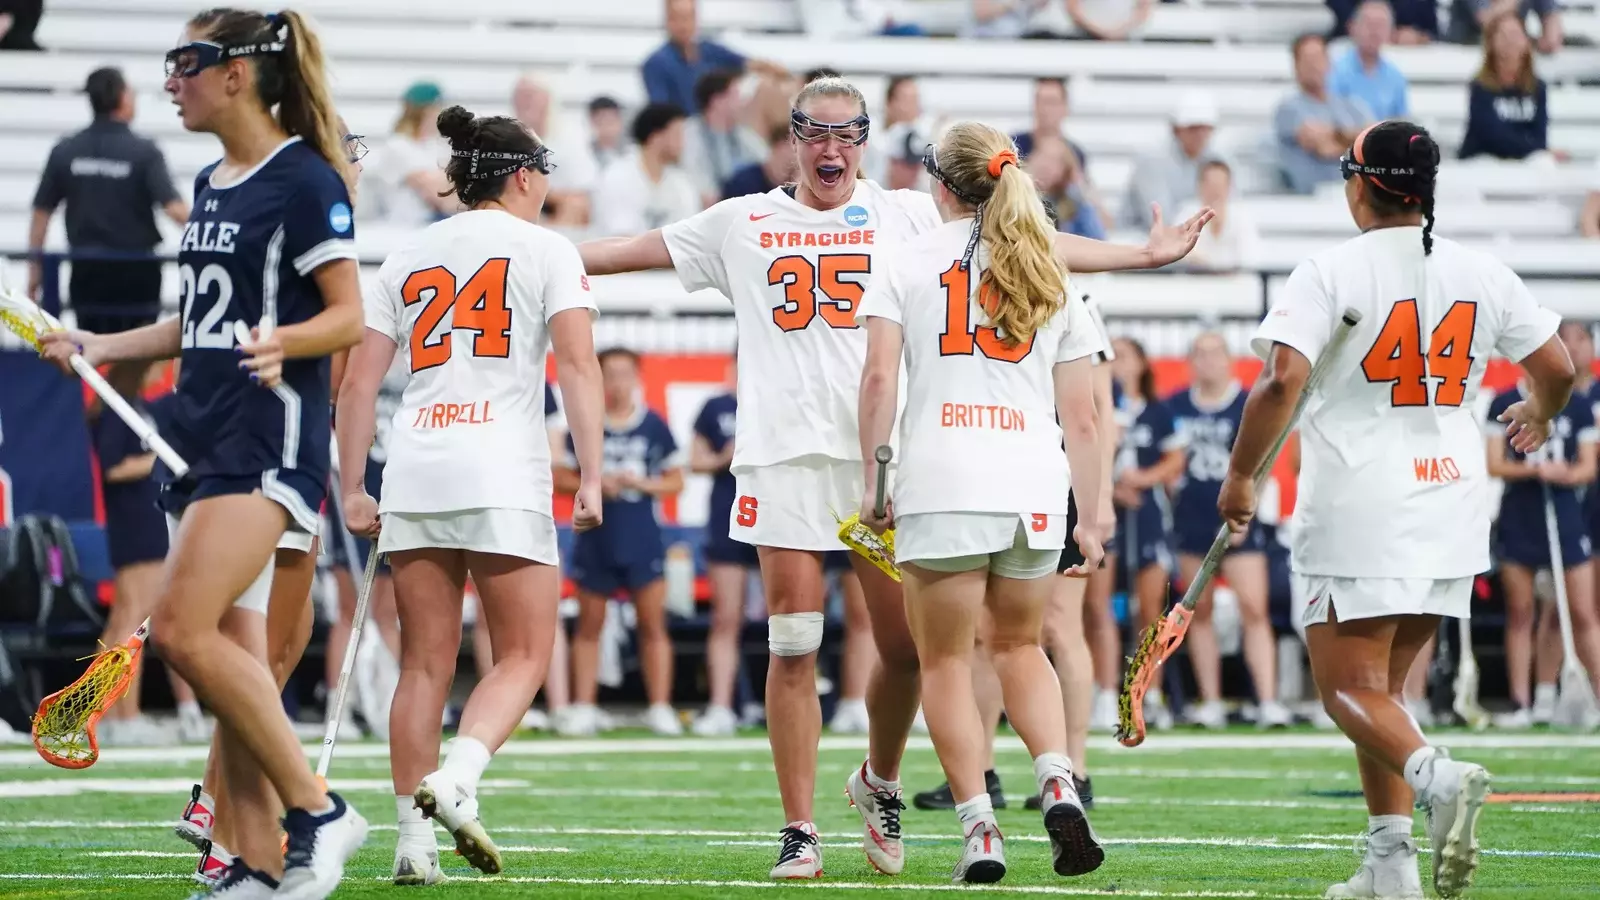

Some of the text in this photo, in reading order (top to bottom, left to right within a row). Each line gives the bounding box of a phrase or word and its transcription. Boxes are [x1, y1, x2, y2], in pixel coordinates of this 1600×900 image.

[228, 44, 256, 57] GAIT
[493, 164, 518, 176] GAIT
[1364, 166, 1386, 174] GAIT
[760, 230, 876, 249] SYRACUSE
[180, 263, 235, 349] 22
[767, 253, 872, 333] 35
[400, 257, 512, 375] 24
[1360, 297, 1477, 408] 44
[412, 400, 495, 429] TYRRELL
[941, 402, 1025, 432] BRITTON
[735, 494, 759, 529] S
